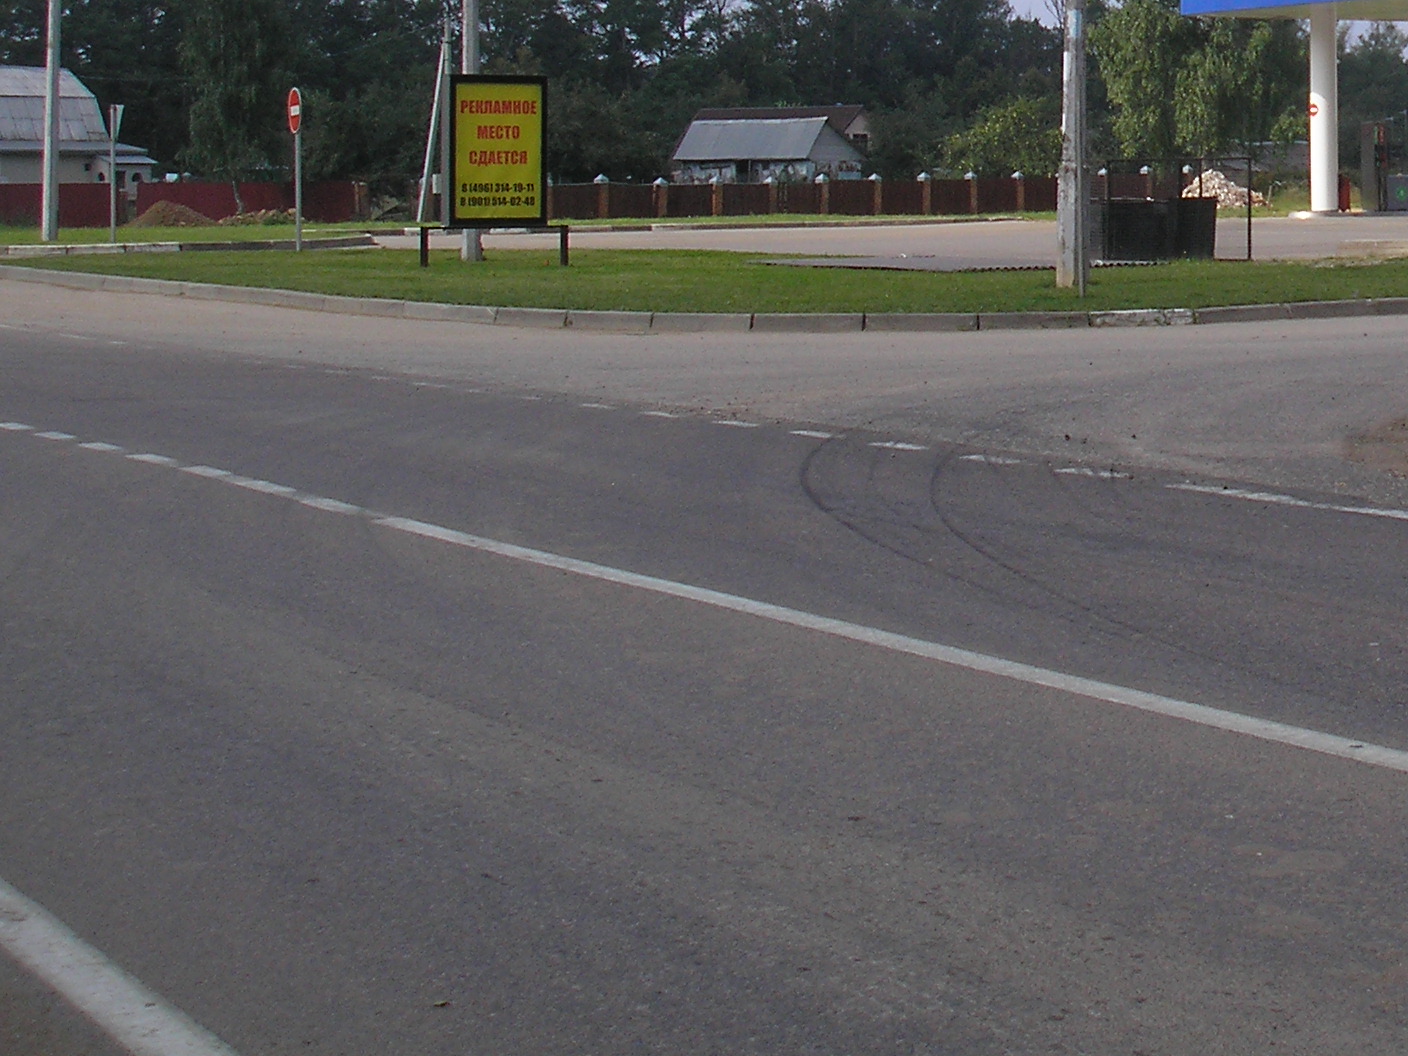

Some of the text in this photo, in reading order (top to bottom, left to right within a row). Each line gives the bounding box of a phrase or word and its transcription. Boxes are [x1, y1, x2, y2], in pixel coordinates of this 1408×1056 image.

[461, 100, 537, 114] РЕКЛАМНОЕ
[477, 126, 520, 139] МЕСТО
[469, 151, 528, 166] СДАЕТСЯ
